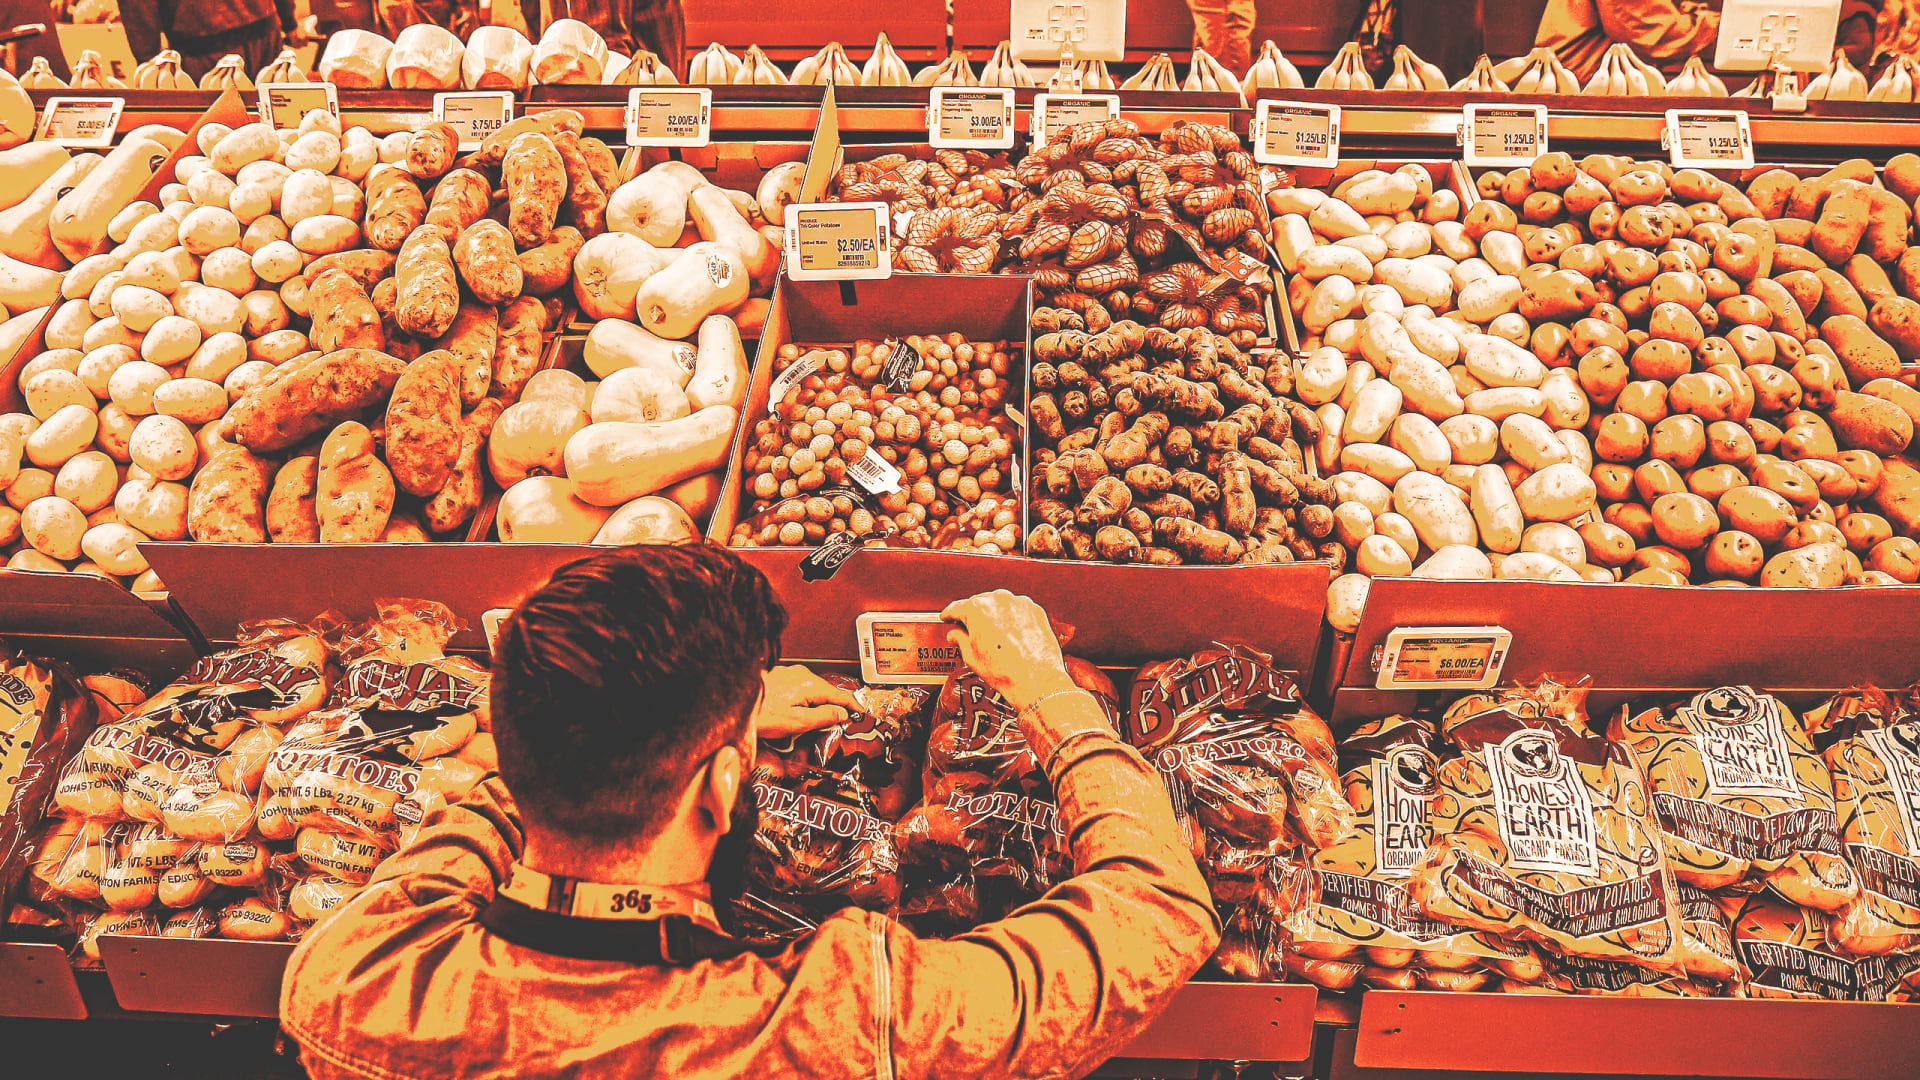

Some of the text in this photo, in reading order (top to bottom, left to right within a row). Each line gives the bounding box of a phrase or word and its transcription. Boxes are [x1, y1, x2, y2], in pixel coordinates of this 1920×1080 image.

[667, 115, 698, 126] $2.00/EA
[970, 116, 1002, 127] $3.00/EA
[1295, 131, 1327, 144] $1.25/LB
[1503, 133, 1535, 144] $1.25/LB
[1708, 138, 1739, 147] $1.25/LB
[837, 238, 875, 252] $2.50/EA
[917, 647, 961, 659] $3.00/EA
[1440, 658, 1485, 668] $6.00/EA
[337, 792, 360, 806] 2.27
[360, 799, 375, 814] kg
[1384, 767, 1433, 824] HONE
[943, 791, 1066, 838] POTAT
[1508, 804, 1582, 839] EARTH
[364, 818, 379, 829] CA
[1713, 805, 1760, 841] ORGANIC
[1763, 811, 1806, 844] YELLOW
[1808, 810, 1840, 834] POTA
[1386, 823, 1435, 849] EART
[358, 844, 376, 858] WT.
[145, 856, 153, 867] 5
[351, 864, 375, 875] FAR
[123, 875, 159, 888] FARMS
[215, 868, 242, 877] 93220
[610, 889, 652, 914] 365
[1558, 886, 1601, 918] YELLOW
[1603, 876, 1652, 909] POTATOES
[1886, 880, 1920, 907] POMME
[1341, 897, 1378, 920] POMMES
[1584, 911, 1613, 936] JAUNE
[1614, 897, 1661, 926] BIOLOGIQUE
[243, 911, 272, 924] 93220
[1750, 943, 1806, 970] CERTIFIED
[1808, 954, 1850, 986] ORGANIC
